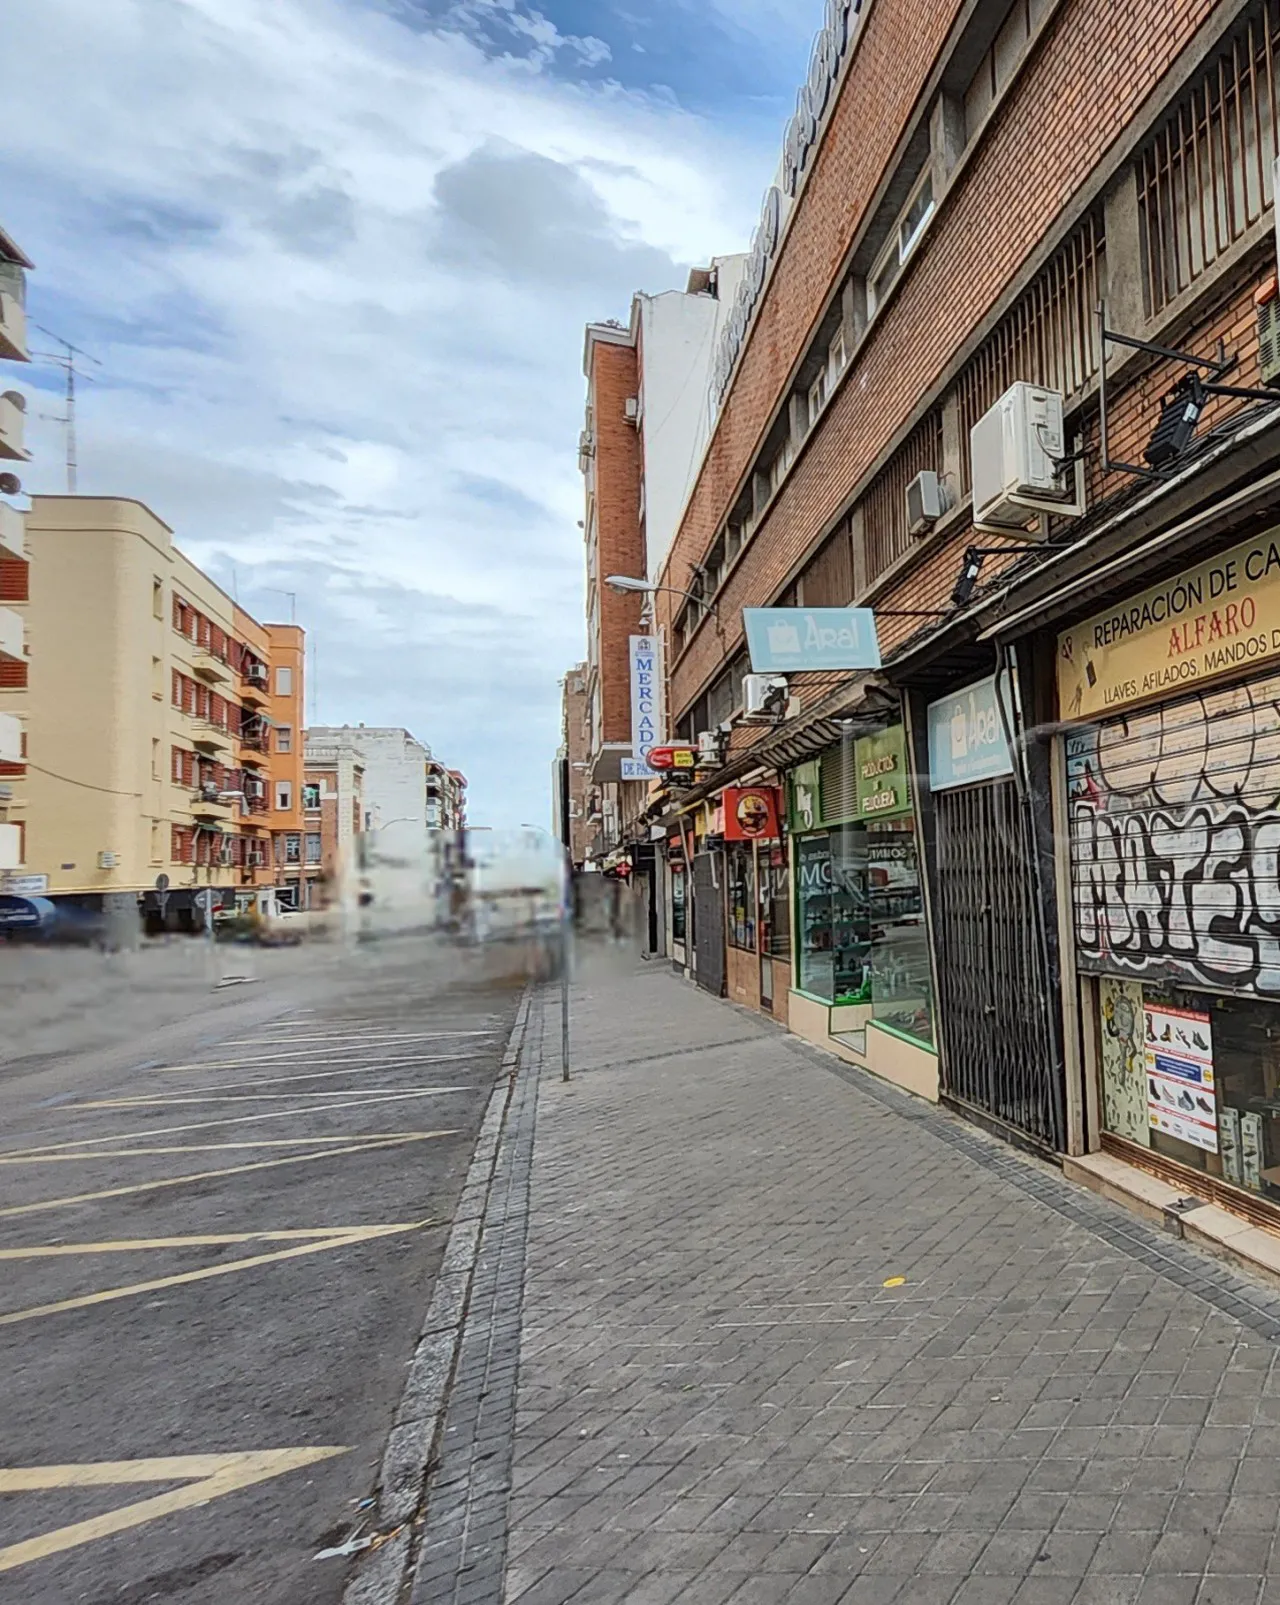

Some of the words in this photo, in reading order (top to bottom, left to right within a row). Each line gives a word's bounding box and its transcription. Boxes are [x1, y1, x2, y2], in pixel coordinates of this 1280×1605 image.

[1094, 577, 1202, 649] REPARACIÓN
[1209, 560, 1237, 599] DE
[1167, 597, 1256, 659] ALFARO
[1104, 680, 1139, 705] LLAVES,
[1142, 658, 1200, 693] AFILADOS,
[1204, 634, 1267, 673] MANDOS
